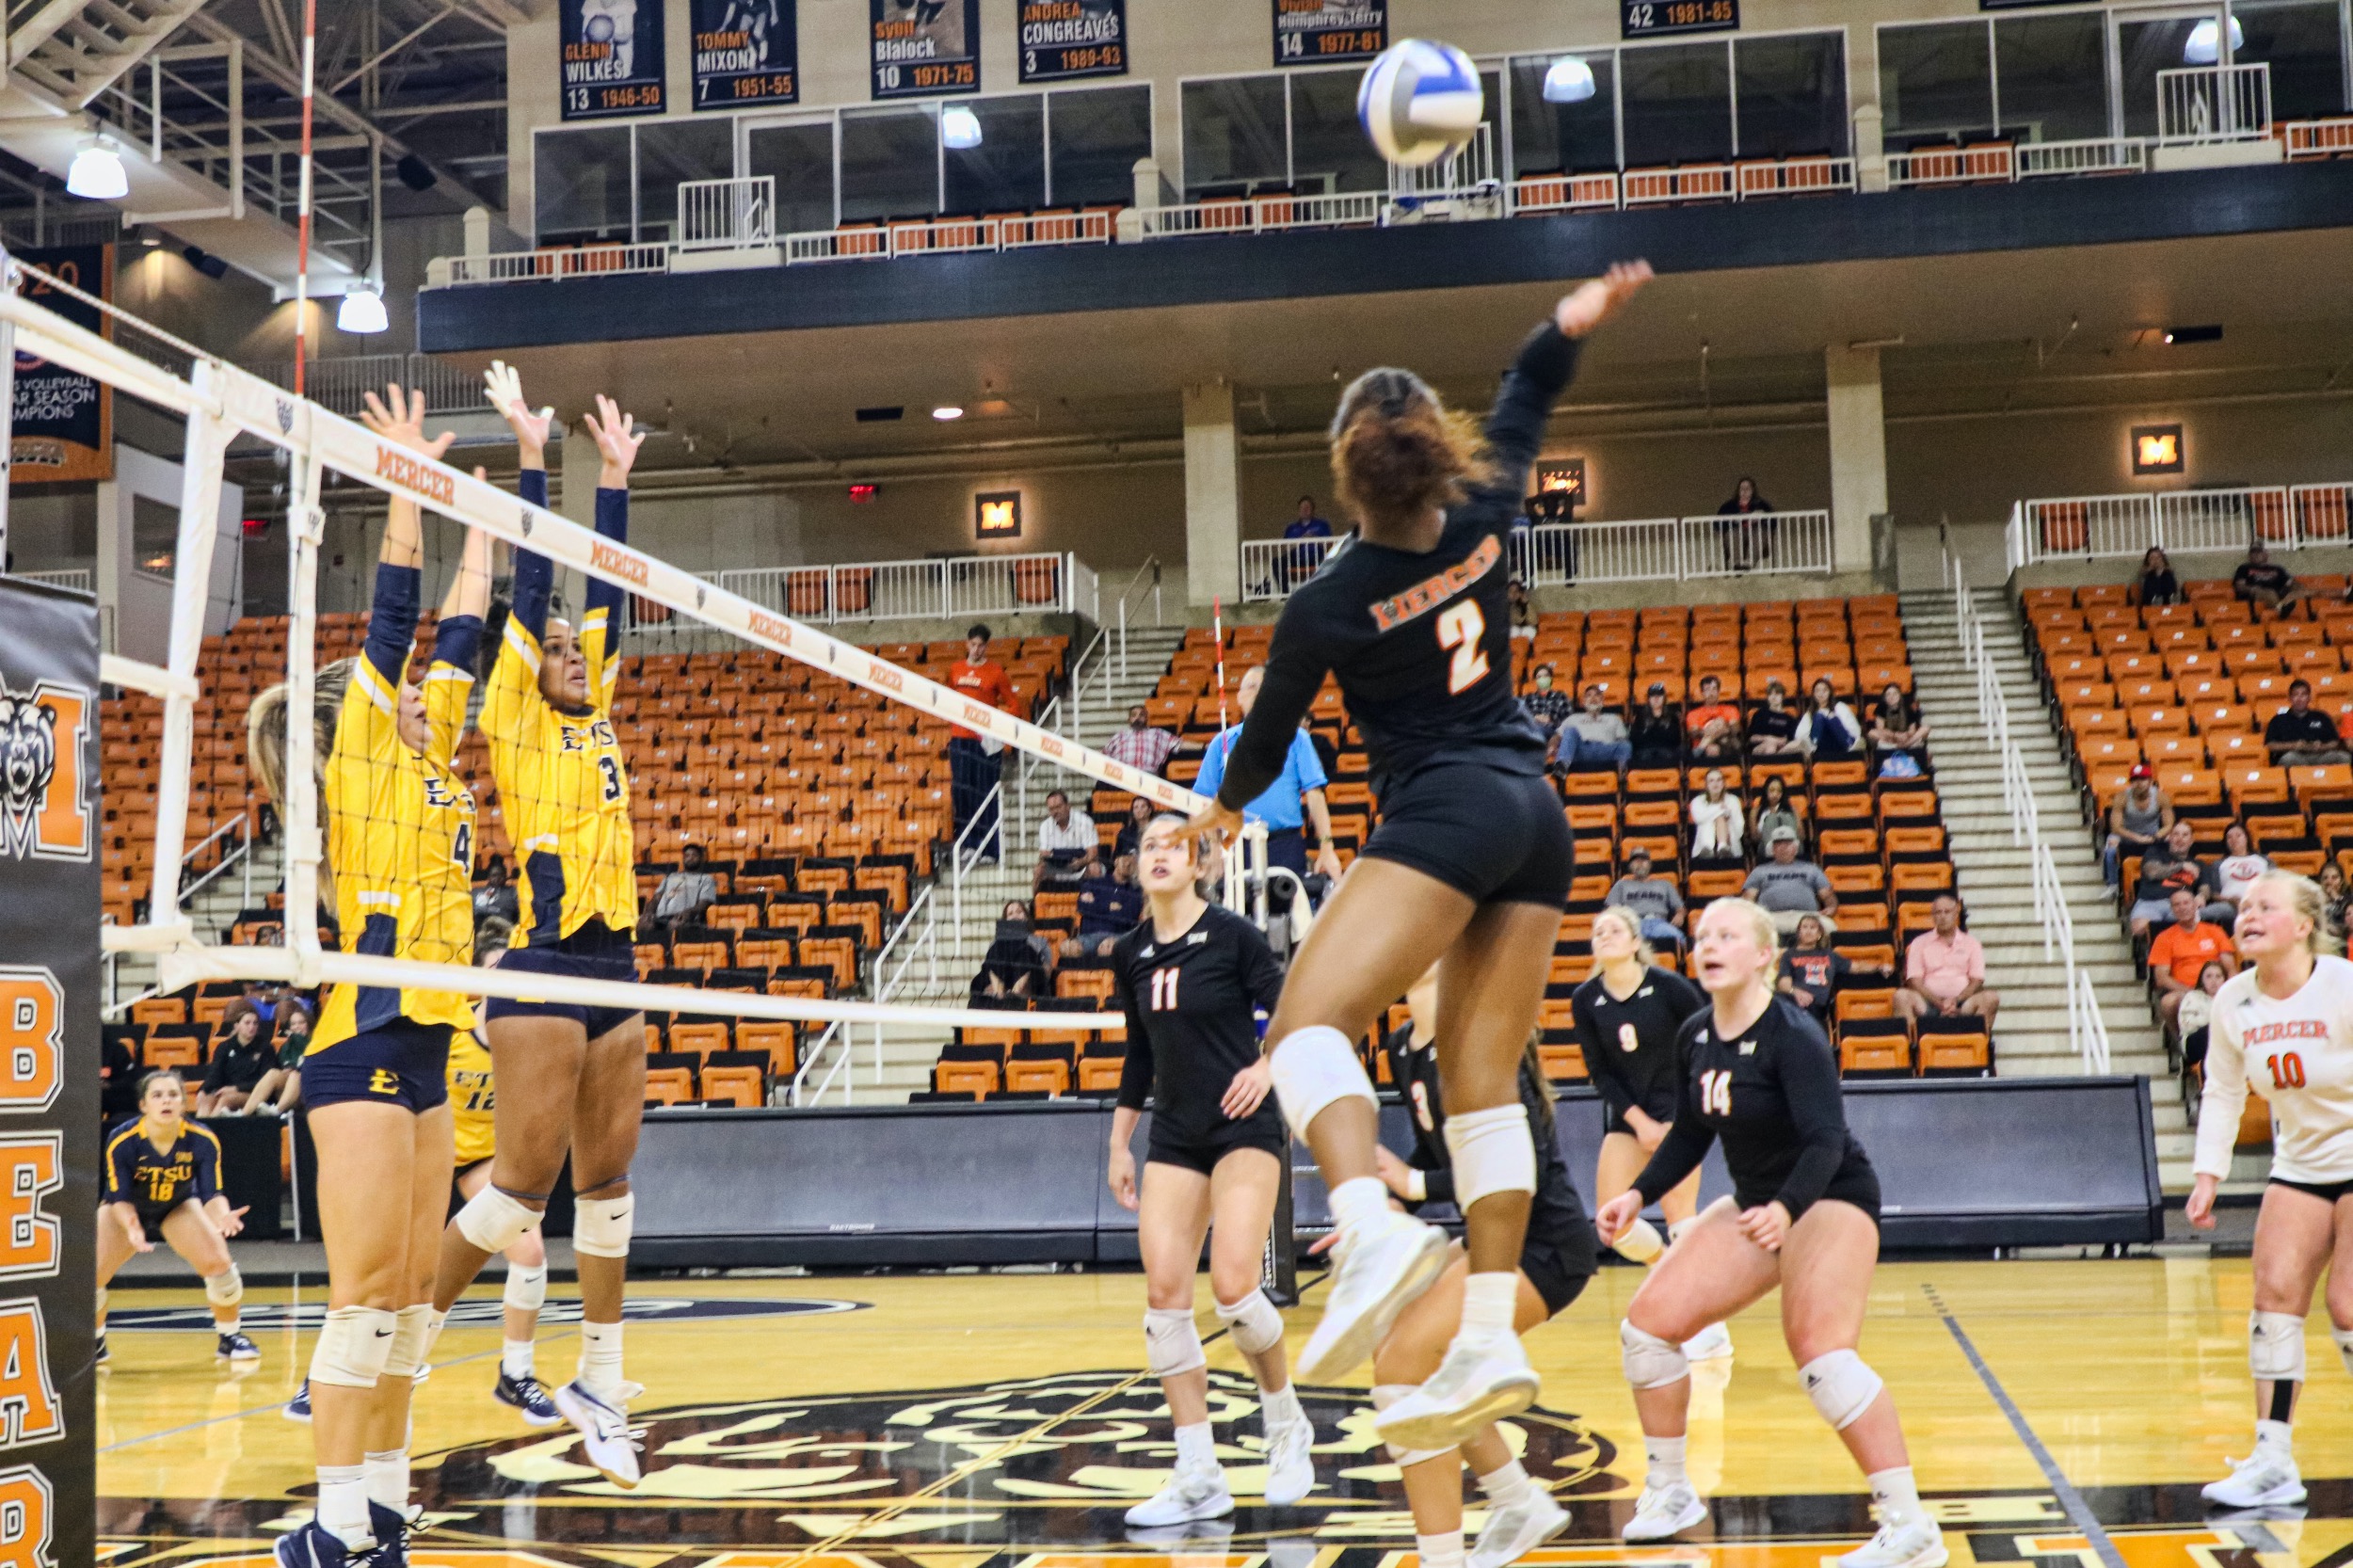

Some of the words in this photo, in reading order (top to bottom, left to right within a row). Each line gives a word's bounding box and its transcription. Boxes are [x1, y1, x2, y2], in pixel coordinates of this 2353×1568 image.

[1024, 2, 1081, 23] ANDREA
[1628, 3, 1655, 29] 42
[1666, 1, 1732, 25] 1981-85
[696, 30, 749, 51] TOMMY
[1023, 14, 1119, 45] CONGREAVES
[565, 42, 610, 61] GLENN
[875, 38, 935, 62] Blalock
[1280, 32, 1304, 56] 14
[1319, 30, 1381, 54] 1977-81
[566, 58, 623, 83] WILKES
[696, 49, 749, 73] MIXON
[1025, 50, 1037, 73] 3
[698, 78, 710, 101] 7
[733, 75, 792, 98] 1951-55
[876, 66, 900, 89] 10
[913, 62, 974, 87] 1971-75
[568, 88, 589, 111] 13
[600, 85, 660, 108] 1946-50
[34, 388, 96, 407] SEASON
[376, 445, 455, 506] MERCER
[590, 540, 649, 588] MERCER
[1434, 597, 1492, 696] 2
[598, 755, 622, 802] 3
[453, 822, 471, 876] 4
[1150, 966, 1181, 1013] 11
[2242, 1018, 2330, 1049] MERCER
[2265, 1050, 2307, 1091] 10
[1699, 1068, 1733, 1117] 14
[134, 1164, 193, 1183] ETSU
[149, 1181, 175, 1203] 18
